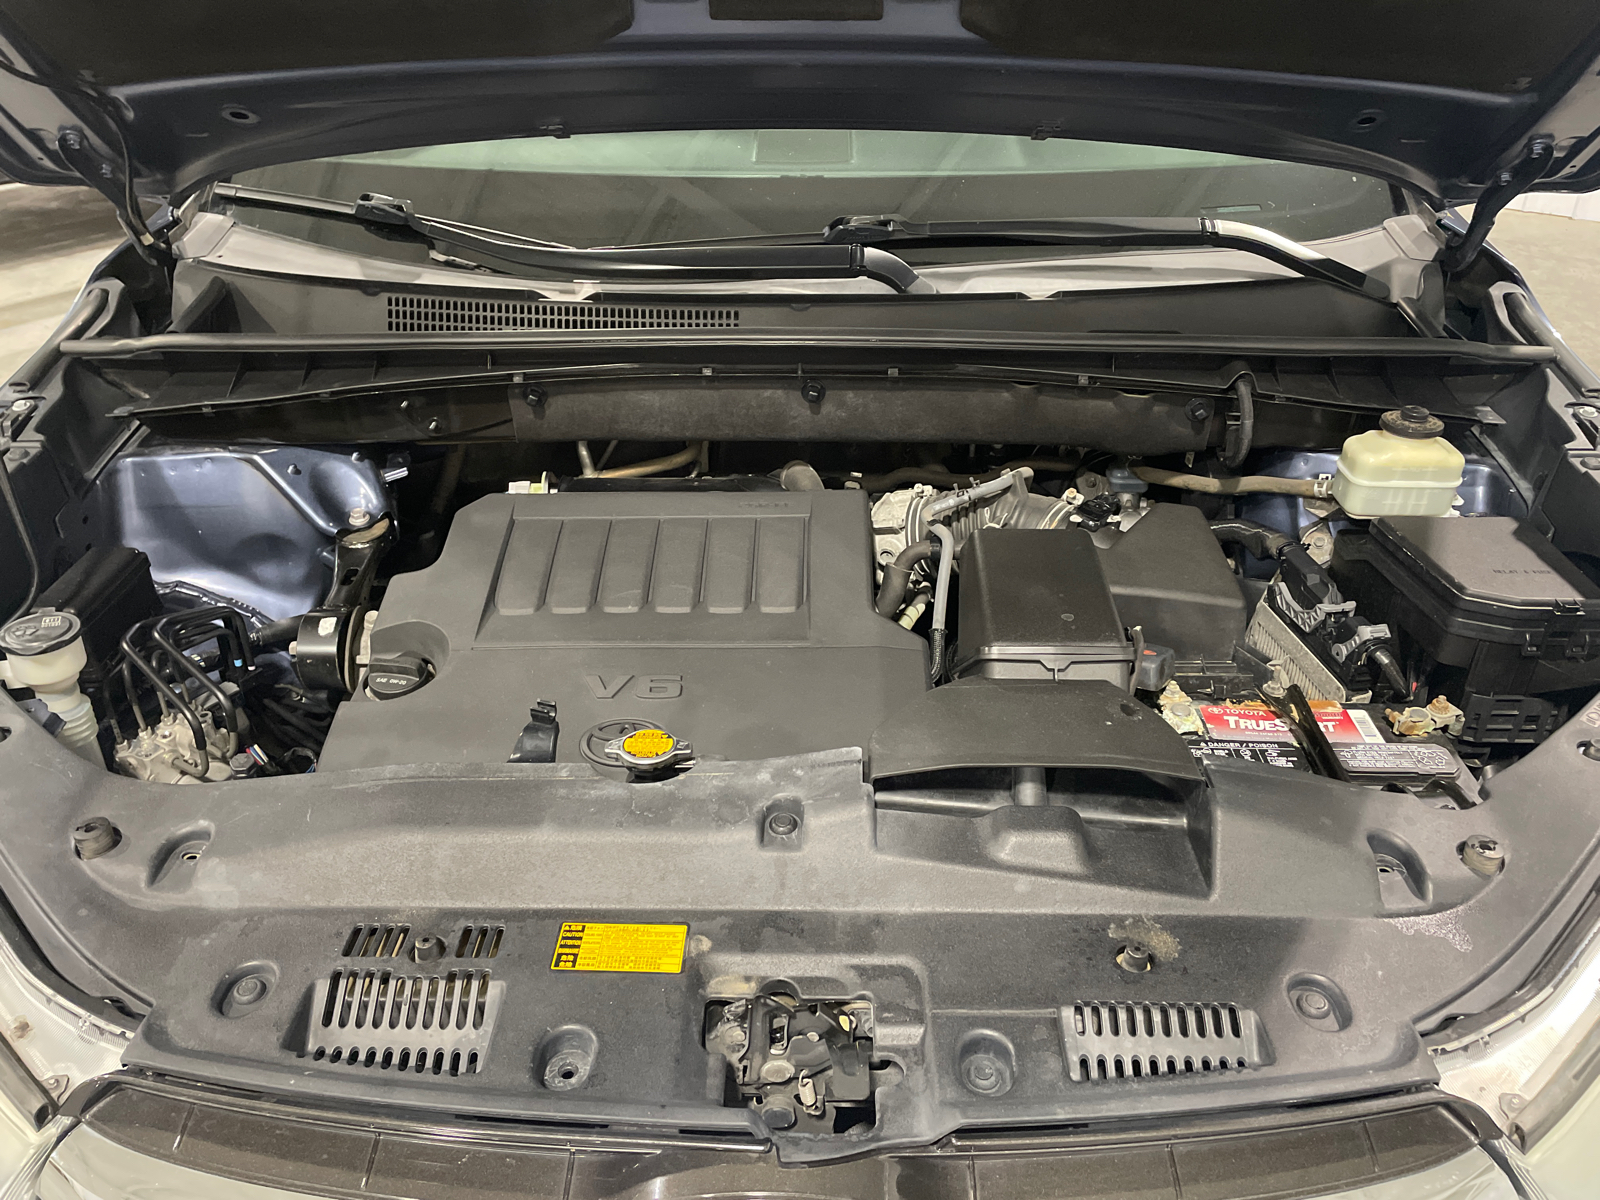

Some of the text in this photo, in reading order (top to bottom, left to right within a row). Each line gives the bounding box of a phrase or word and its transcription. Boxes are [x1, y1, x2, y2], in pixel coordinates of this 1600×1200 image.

[583, 674, 683, 700] V6
[1224, 708, 1267, 717] TOYOTA
[1223, 715, 1336, 732] TRUESRT
